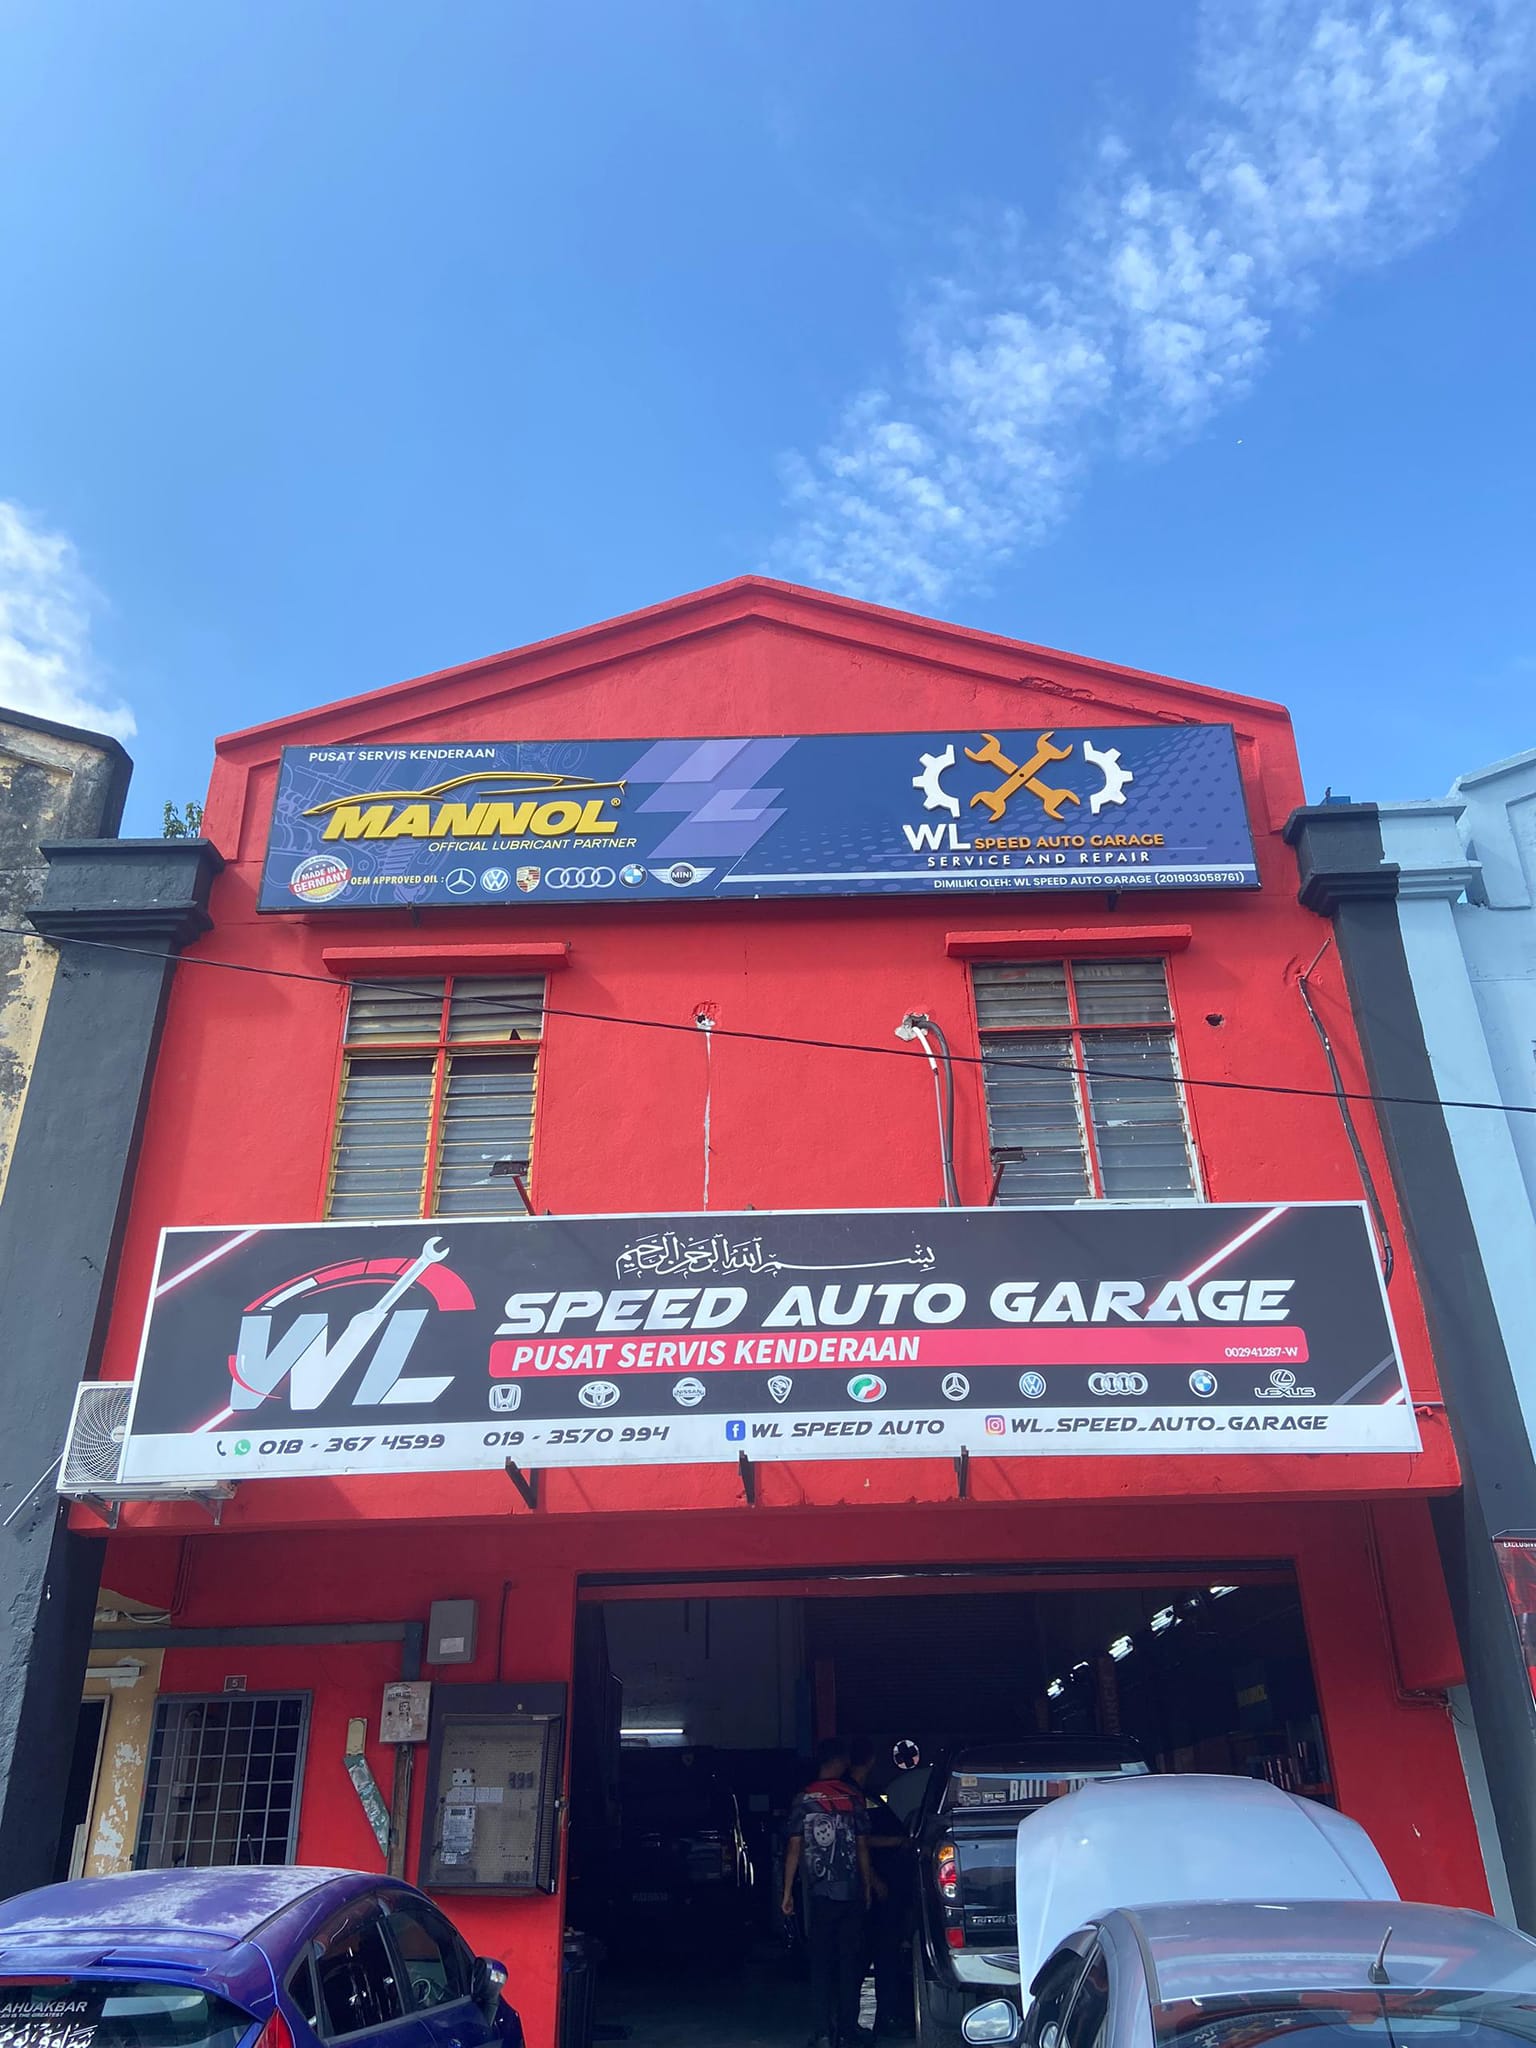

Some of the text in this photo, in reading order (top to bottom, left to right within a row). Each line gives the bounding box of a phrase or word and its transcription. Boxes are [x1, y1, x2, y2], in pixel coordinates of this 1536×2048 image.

[309, 748, 496, 762] PUSAT SERVIS KENDERAAN
[321, 799, 620, 840] MANNOL
[428, 837, 638, 852] OFFICIAL LUBRICANT PARTNER
[902, 823, 1165, 851] WL SPEED AUTO GARAGE
[927, 851, 1151, 867] SERVICE AND REPAIR
[293, 870, 349, 894] GERMANY
[301, 866, 337, 881] MADE IN
[350, 877, 371, 886] OEM
[373, 875, 421, 885] APPROVED
[423, 875, 439, 884] OIL
[672, 871, 692, 879] MINI
[934, 871, 1245, 889] DIMILIKI OLEH: WL SPEED AUTO GARAGE (201903058761)
[494, 1279, 1296, 1335] SPEED AUTO GARAGE
[229, 1308, 456, 1411] WL
[511, 1335, 920, 1372] PUSAT SERVIS KENDERAAN
[1224, 1346, 1298, 1358] 002941287-W
[1254, 1386, 1316, 1399] LEXUS
[751, 1420, 945, 1438] WL SPEED AUTO
[1011, 1415, 1329, 1433] WL_SPEED_AUTO_GARAGE
[258, 1439, 303, 1455] 018
[324, 1437, 375, 1452] 367
[381, 1433, 446, 1450] 4599
[483, 1431, 525, 1447] 019
[546, 1427, 614, 1445] 3570
[619, 1426, 670, 1442] 994
